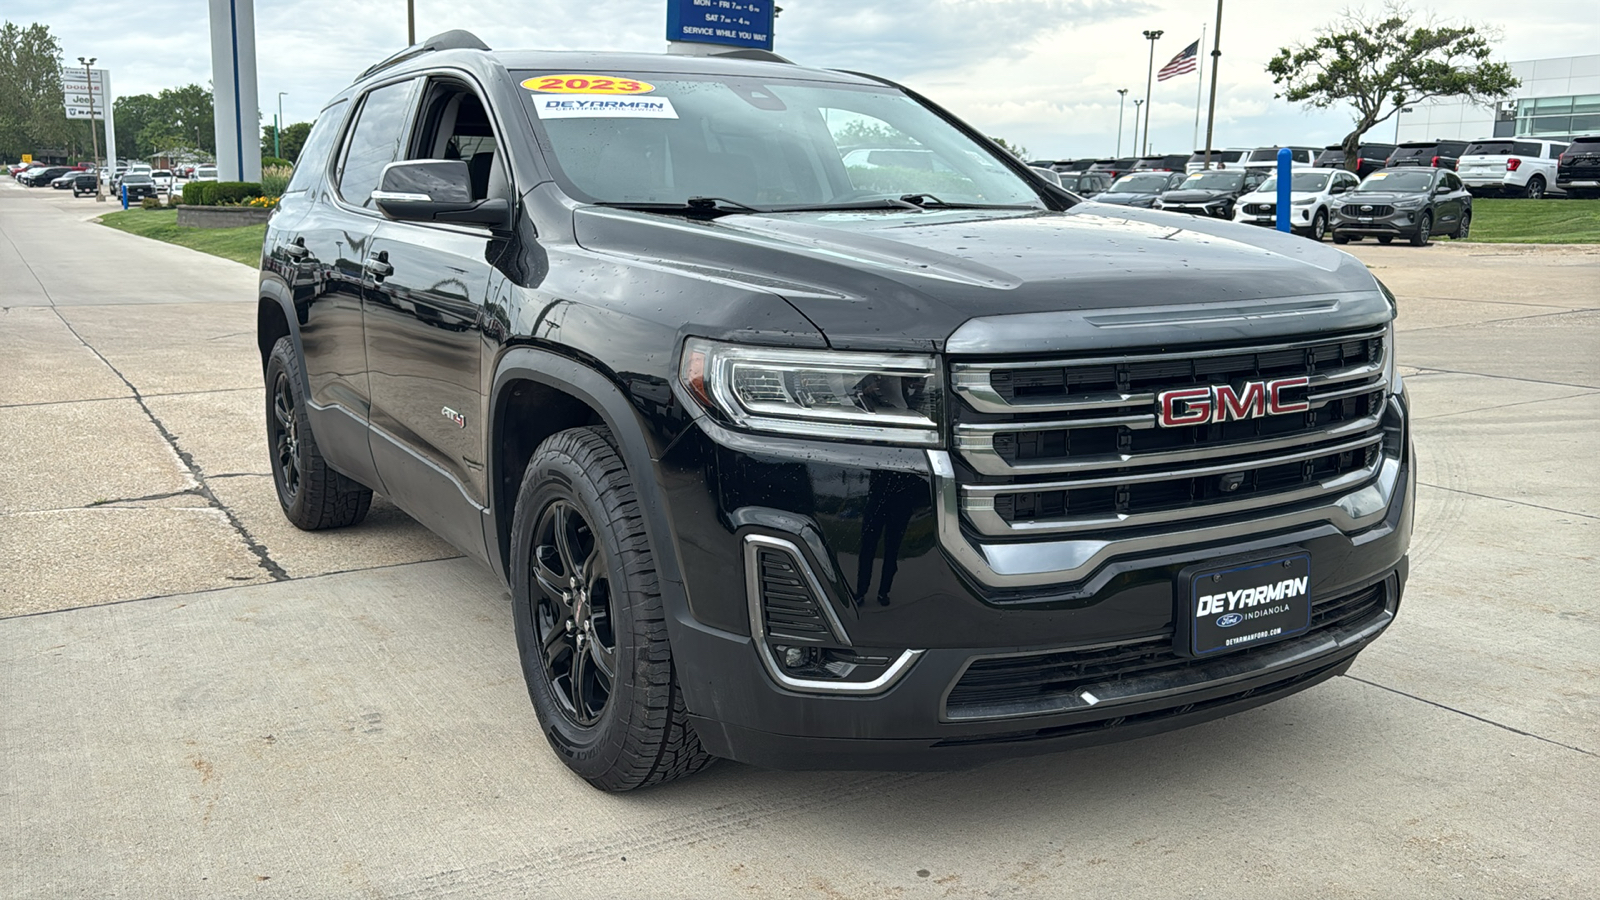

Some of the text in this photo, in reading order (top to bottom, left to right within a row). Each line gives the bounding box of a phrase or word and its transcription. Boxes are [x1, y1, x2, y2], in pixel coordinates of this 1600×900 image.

[705, 13, 719, 21] SAT
[683, 26, 714, 36] SERVICE
[716, 29, 737, 38] WHILE
[738, 31, 752, 40] YOU
[538, 78, 642, 92] 2023
[545, 100, 664, 109] DEYARMAN
[1157, 376, 1310, 428] GMC
[1196, 576, 1309, 617] DEYARMAN
[1220, 603, 1290, 625] Ford INDIANOLA
[1225, 627, 1282, 646] DEYARMANFORD.COM
